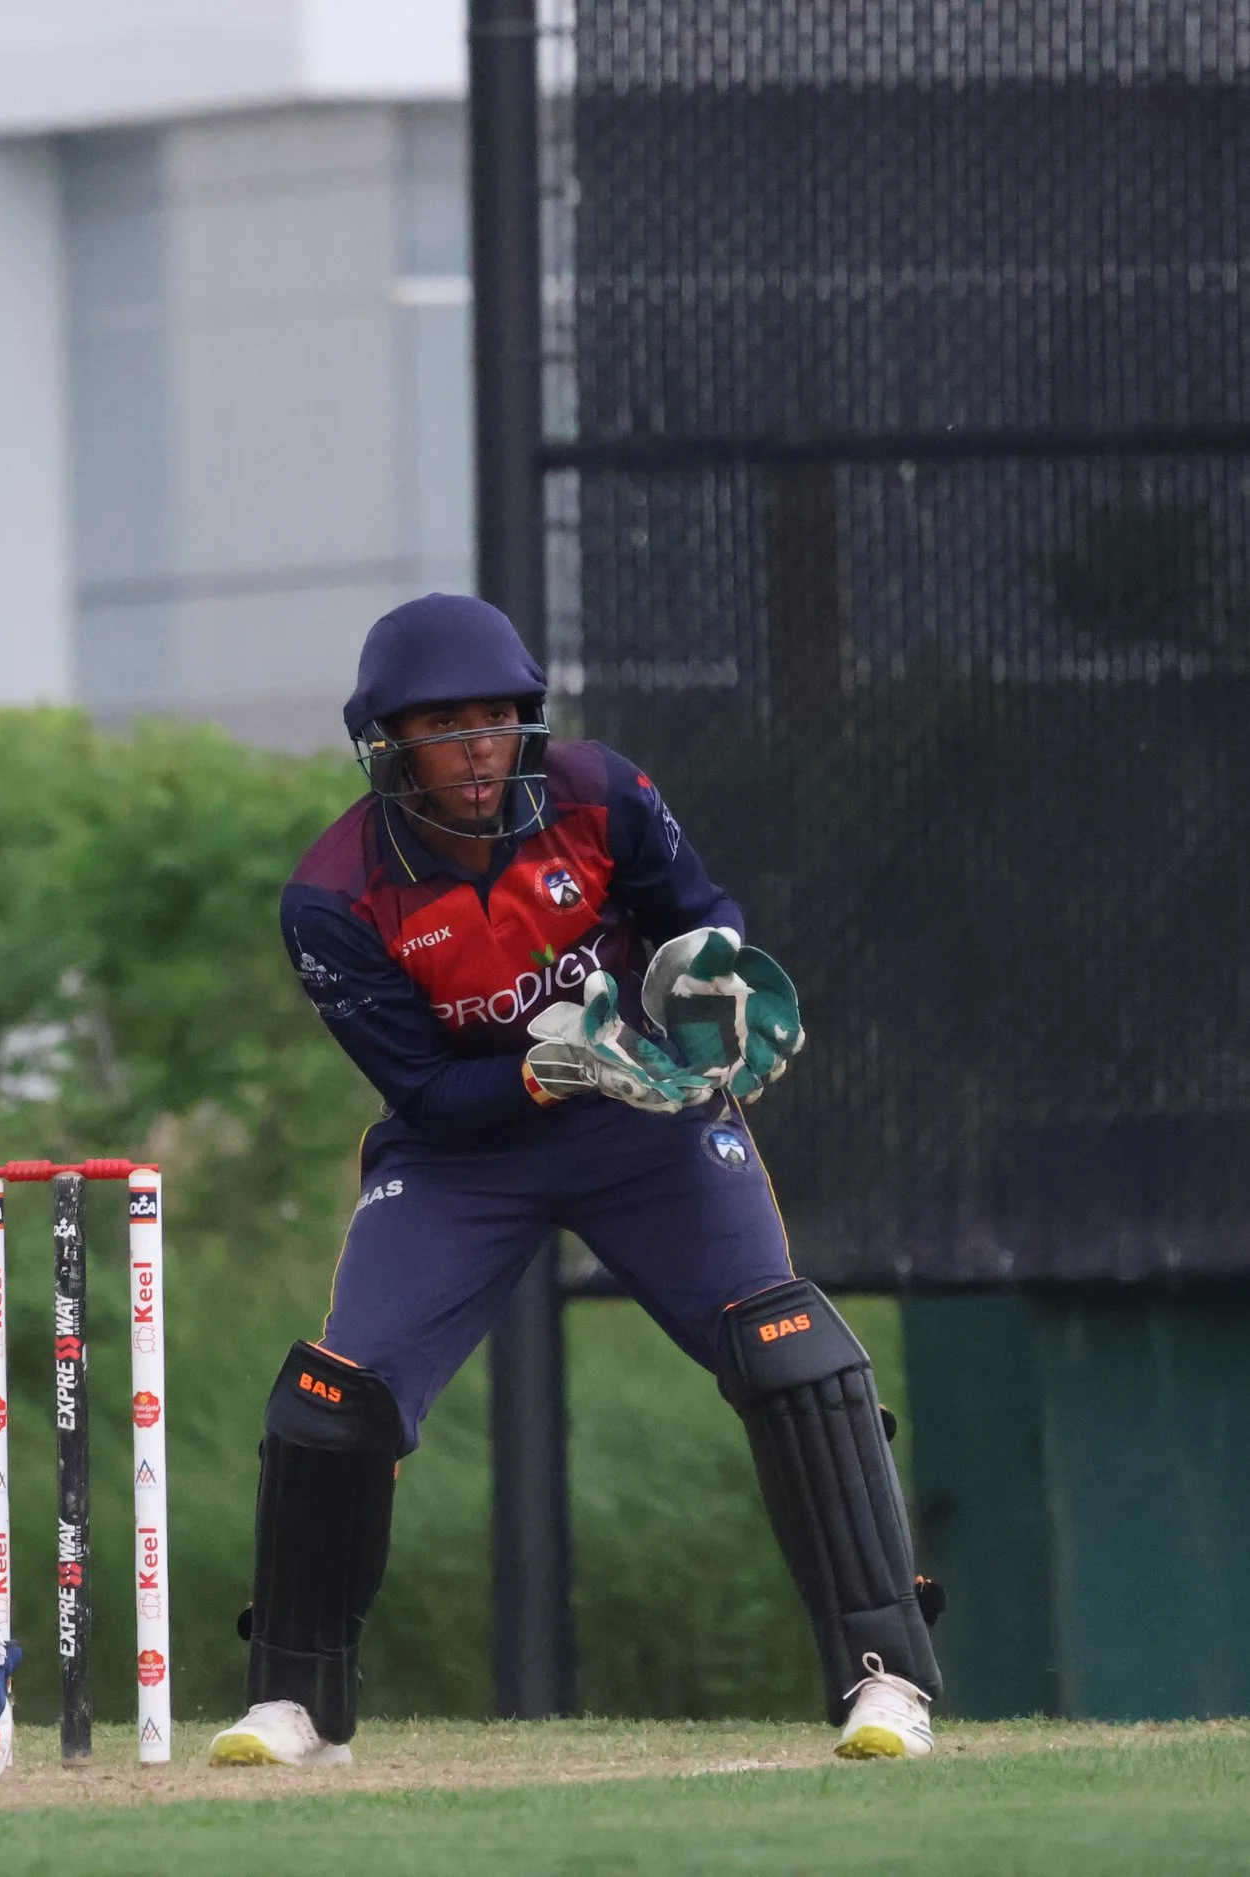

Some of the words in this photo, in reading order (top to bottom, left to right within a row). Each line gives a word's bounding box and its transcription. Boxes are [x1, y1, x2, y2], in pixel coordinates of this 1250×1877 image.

[430, 933, 606, 1026] PRODIGY
[130, 1201, 156, 1215] OCA
[54, 1224, 76, 1239] OCA
[133, 1263, 153, 1322] Keel
[759, 1313, 811, 1342] BAS
[300, 1372, 342, 1403] BAS
[138, 1528, 159, 1589] Keel
